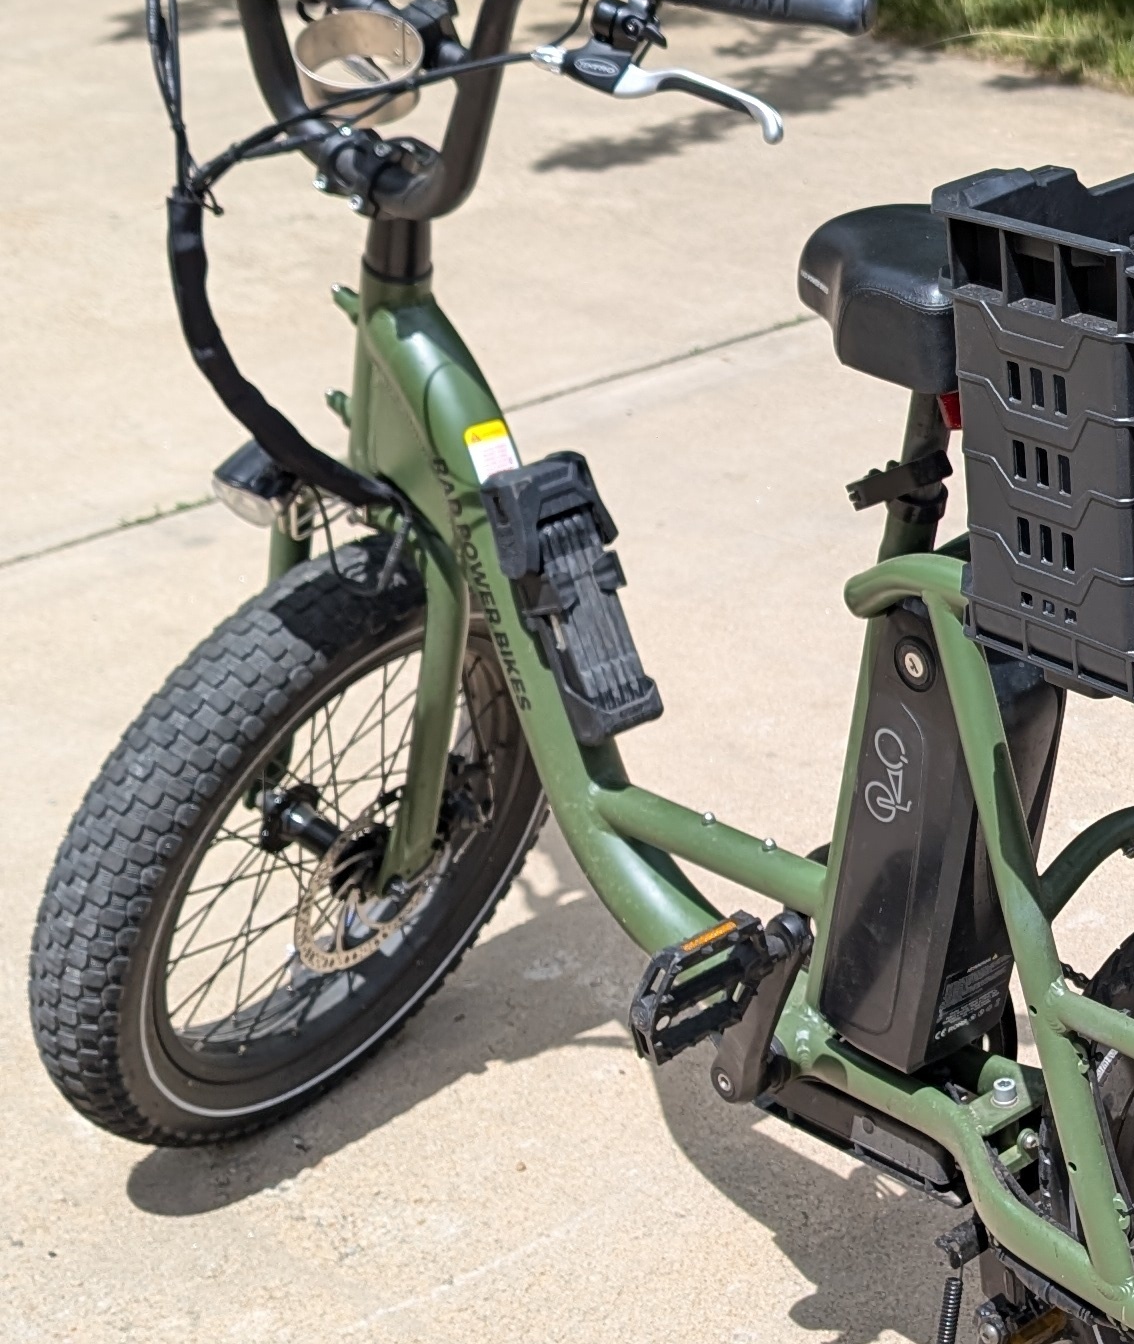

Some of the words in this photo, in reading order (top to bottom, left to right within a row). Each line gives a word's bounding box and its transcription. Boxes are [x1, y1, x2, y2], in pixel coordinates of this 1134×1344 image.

[432, 457, 463, 518] RAD
[456, 524, 502, 626] POWER
[494, 631, 532, 712] BIKES
